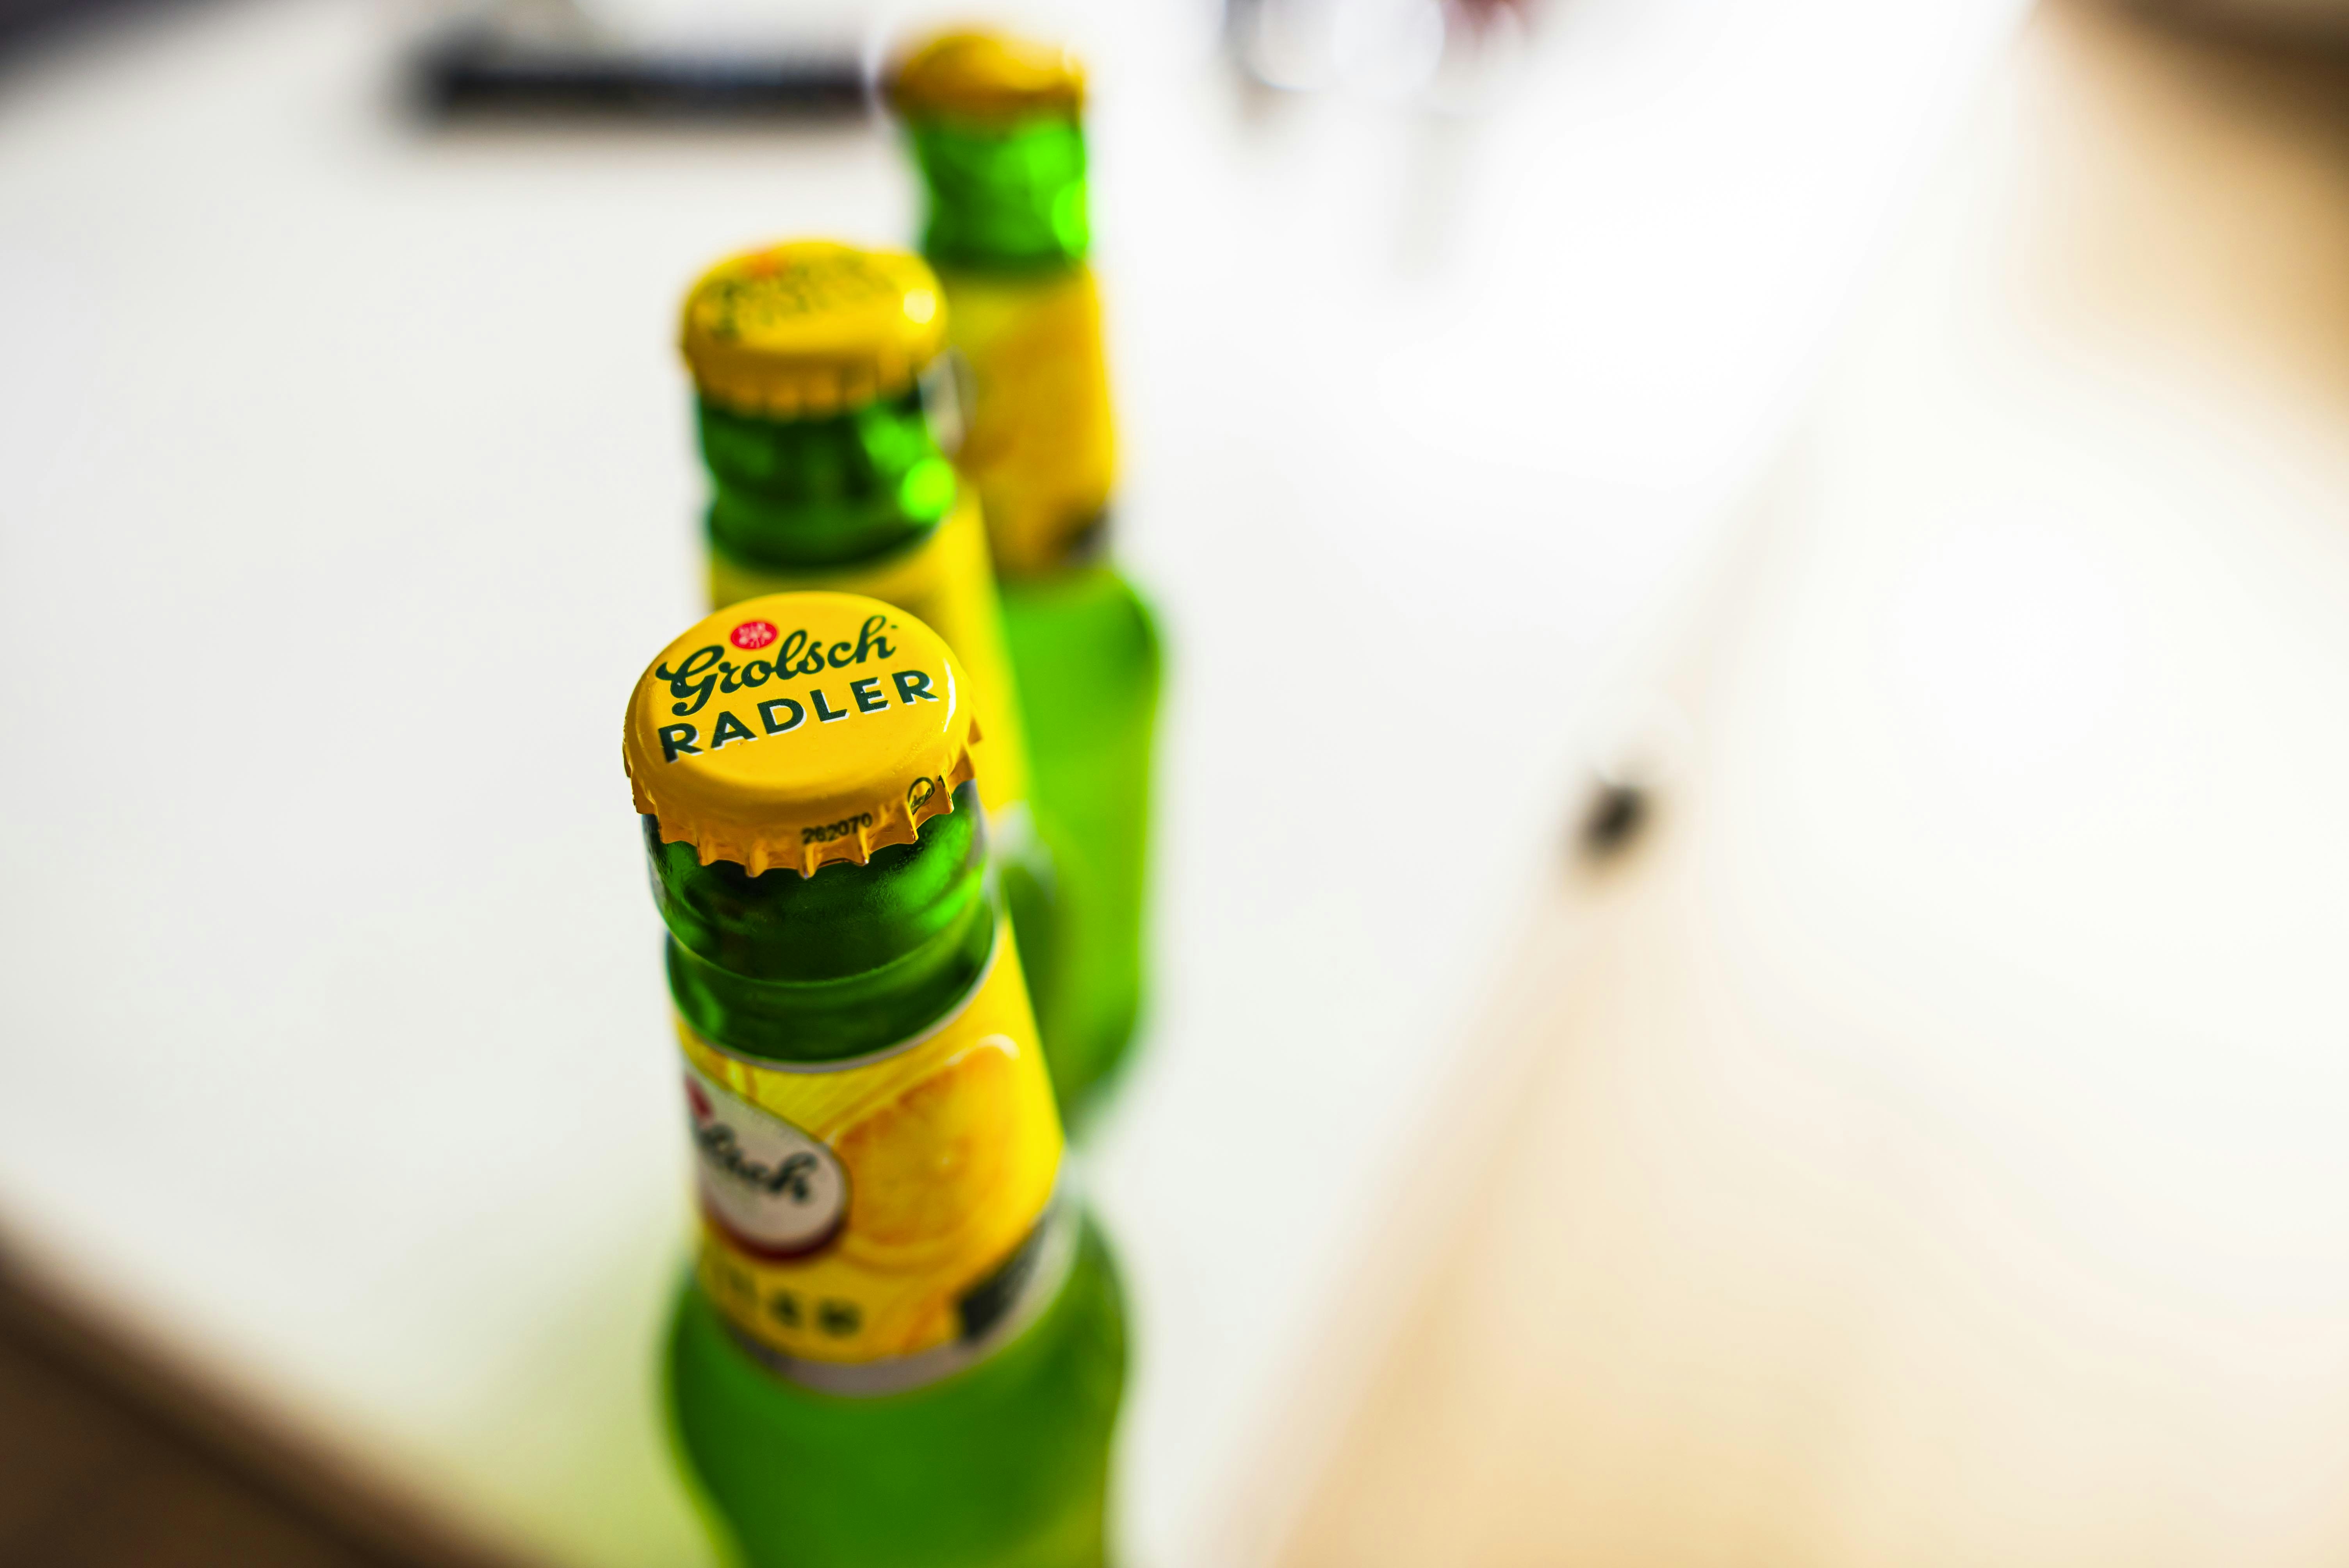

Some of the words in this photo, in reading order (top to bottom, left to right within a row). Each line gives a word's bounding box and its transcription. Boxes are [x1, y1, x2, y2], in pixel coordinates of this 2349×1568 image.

[656, 615, 897, 716] Grolsch
[658, 670, 939, 763] RADLER
[802, 813, 873, 845] 262070
